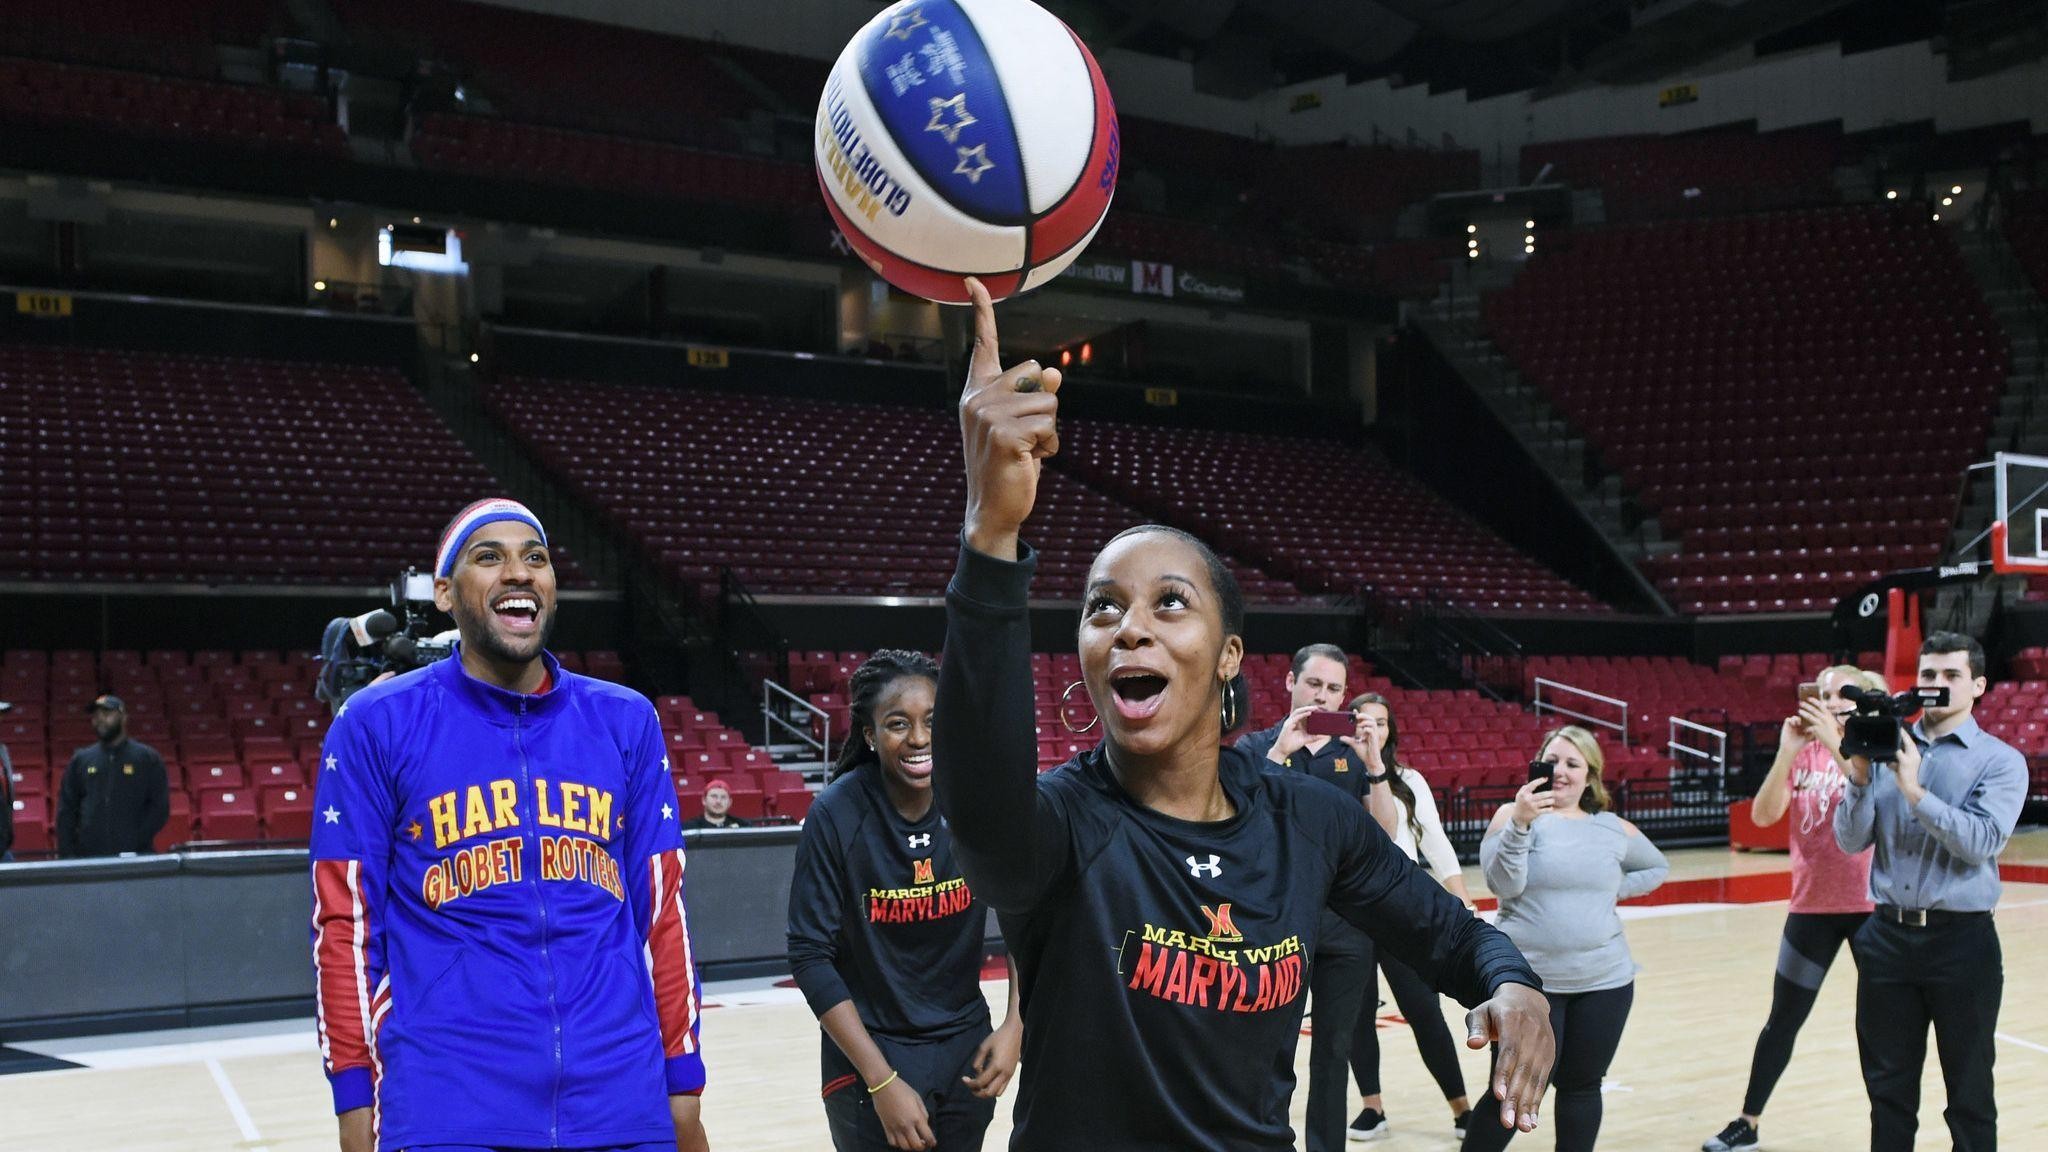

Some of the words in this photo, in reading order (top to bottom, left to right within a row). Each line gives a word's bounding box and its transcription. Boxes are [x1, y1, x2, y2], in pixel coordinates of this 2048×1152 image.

[29, 294, 61, 312] 101
[913, 857, 935, 885] M
[869, 884, 972, 923] MARYLAND
[870, 887, 933, 900] MARCH
[1199, 903, 1244, 942] M
[1128, 941, 1302, 1013] MARYLAND
